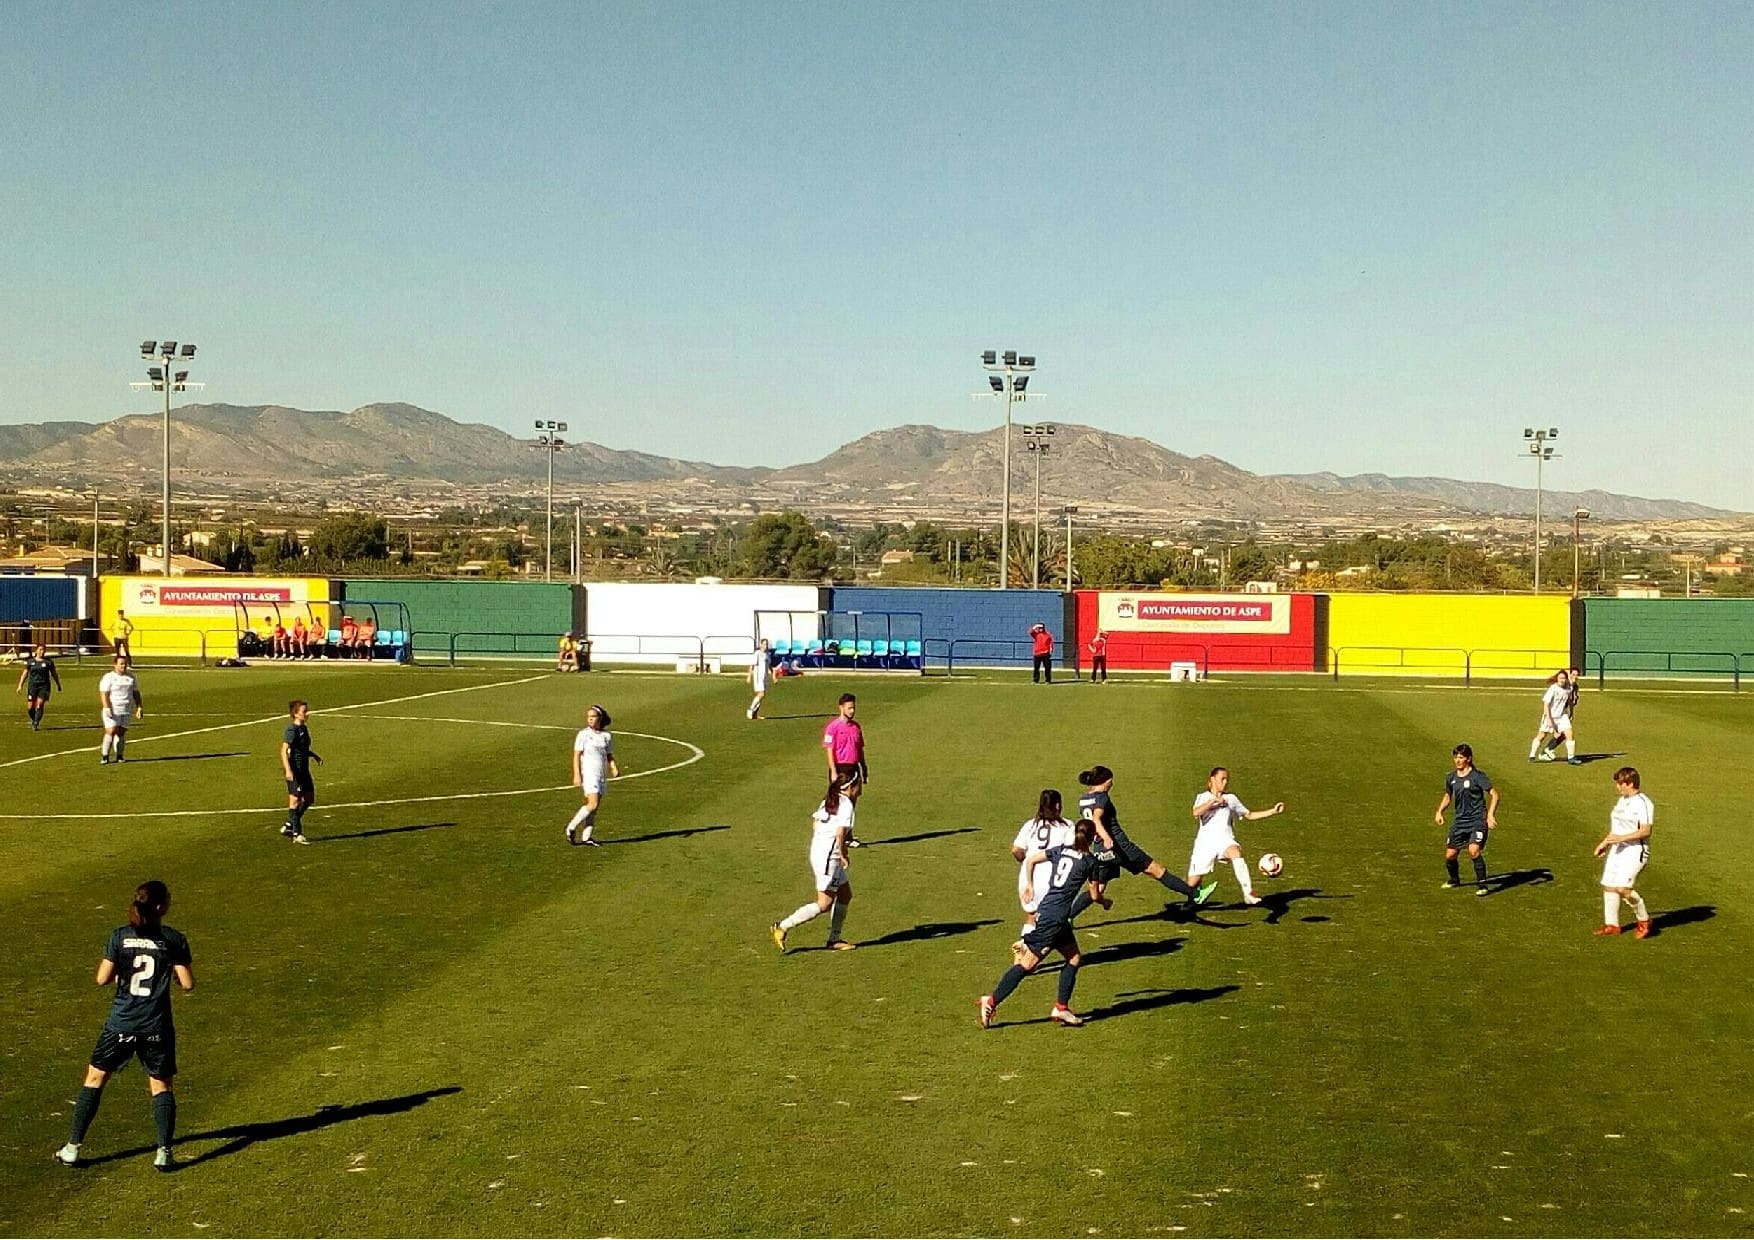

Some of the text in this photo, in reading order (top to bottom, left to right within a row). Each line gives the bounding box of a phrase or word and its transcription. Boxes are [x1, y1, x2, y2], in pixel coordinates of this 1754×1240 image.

[163, 591, 281, 602] AYUNTAMIENTO DE ASPE
[1142, 606, 1262, 617] AYUNTAMIENTO DE ASPE
[1037, 824, 1051, 850] 9
[1053, 857, 1074, 888] 9
[130, 954, 155, 997] 2
